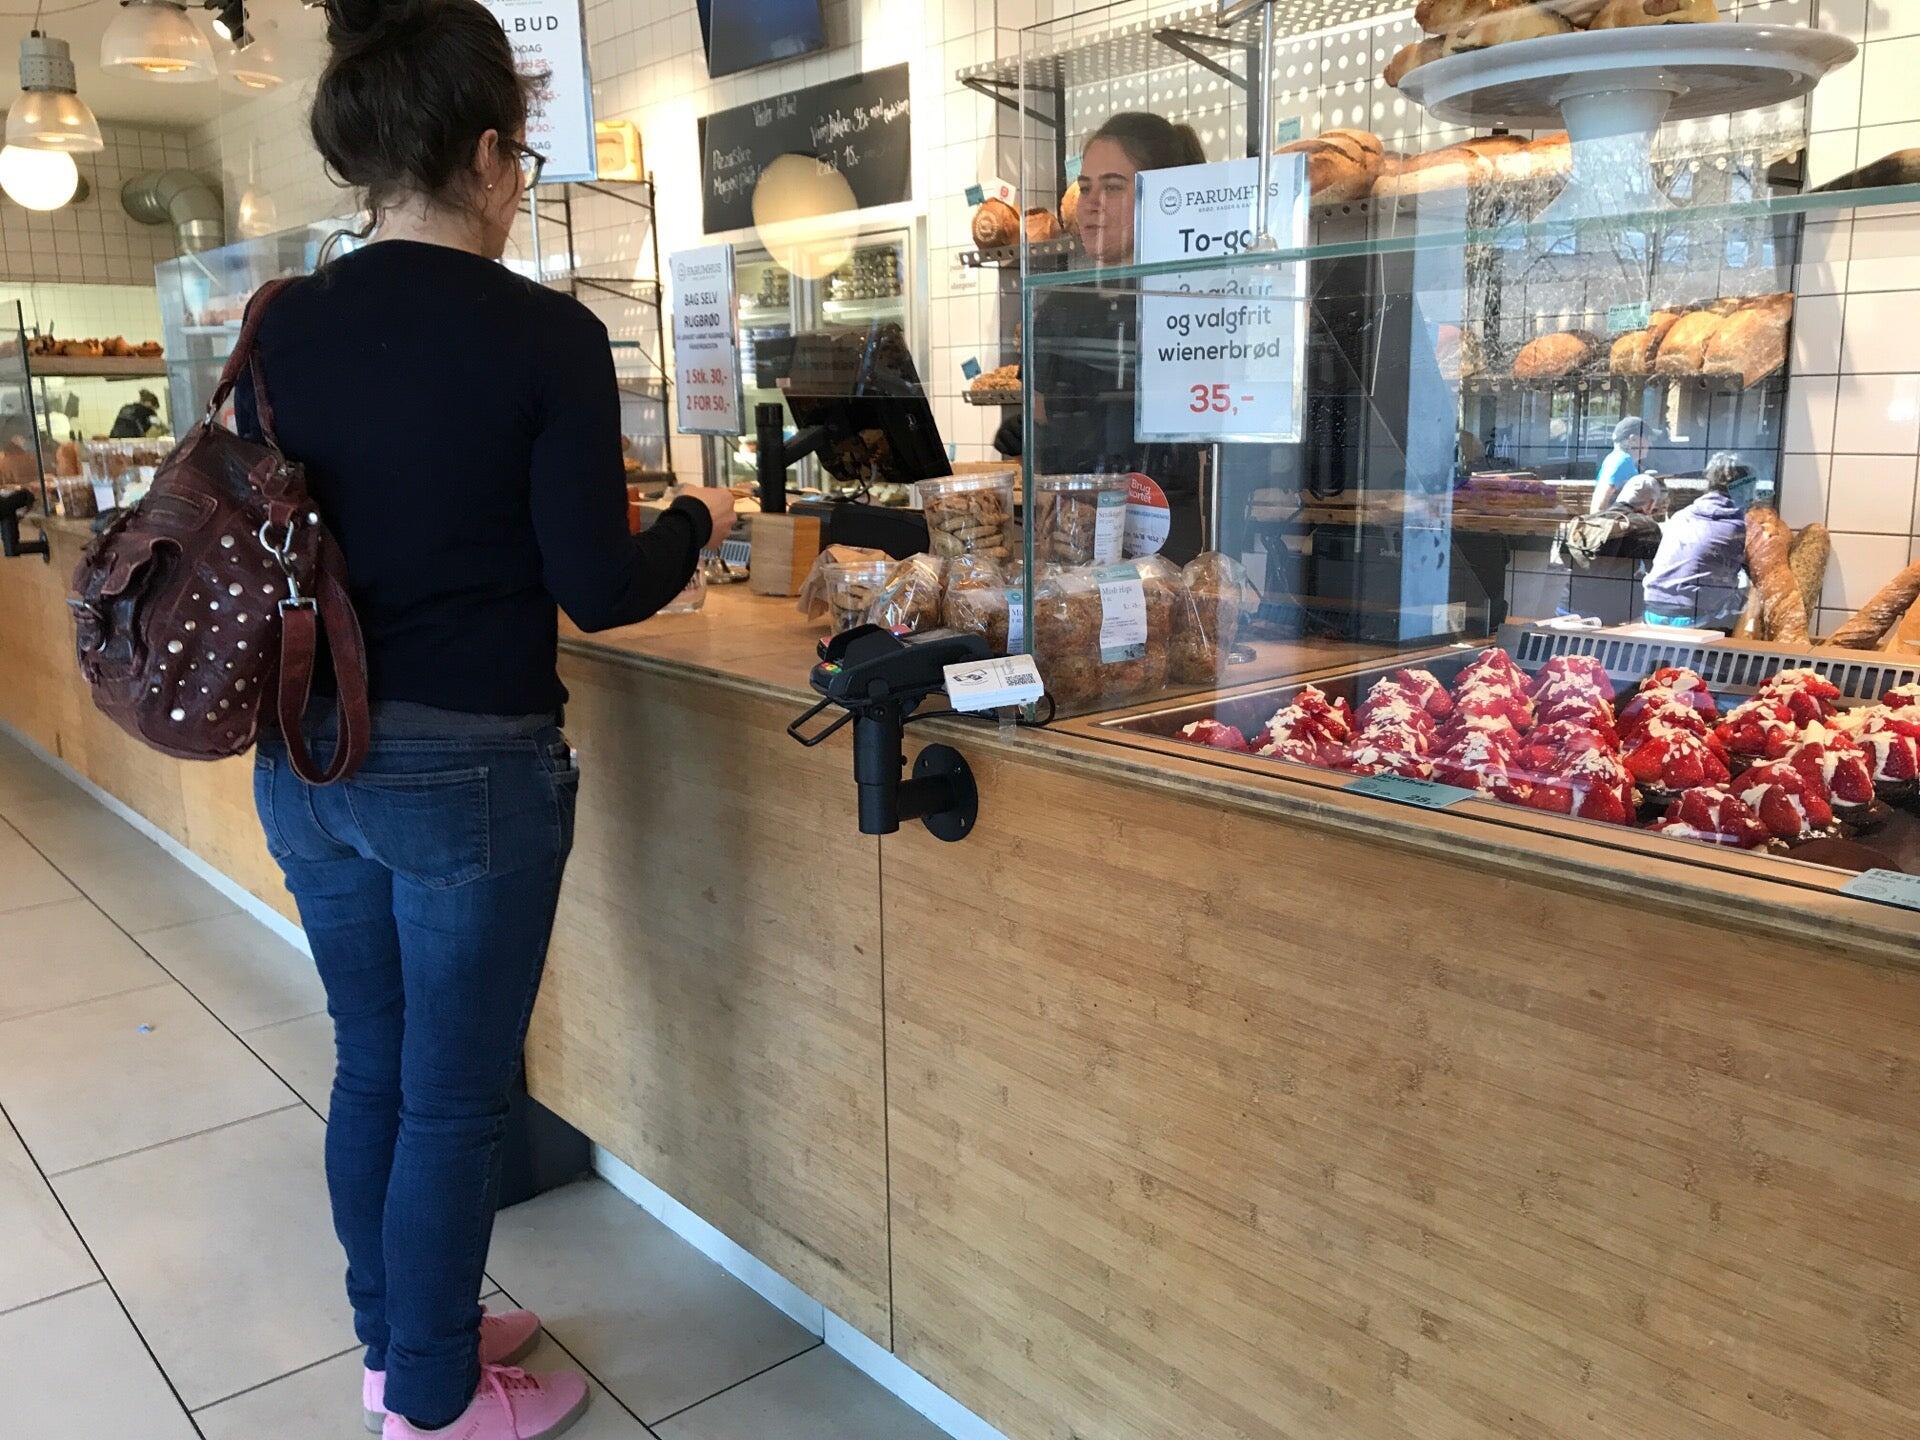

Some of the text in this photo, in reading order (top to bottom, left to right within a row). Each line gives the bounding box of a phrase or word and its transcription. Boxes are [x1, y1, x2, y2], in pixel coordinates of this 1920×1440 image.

[501, 16, 559, 33] LBUD
[1186, 182, 1280, 207] FARUMHS
[684, 291, 718, 307] BAG SELV
[684, 313, 721, 329] RUGBRØD
[1166, 305, 1272, 337] og valgfrit
[1158, 337, 1281, 362] wienerbrød
[686, 395, 730, 413] 2 FOR 50,-
[1189, 383, 1255, 416] 35,-
[1130, 478, 1152, 496] Brug
